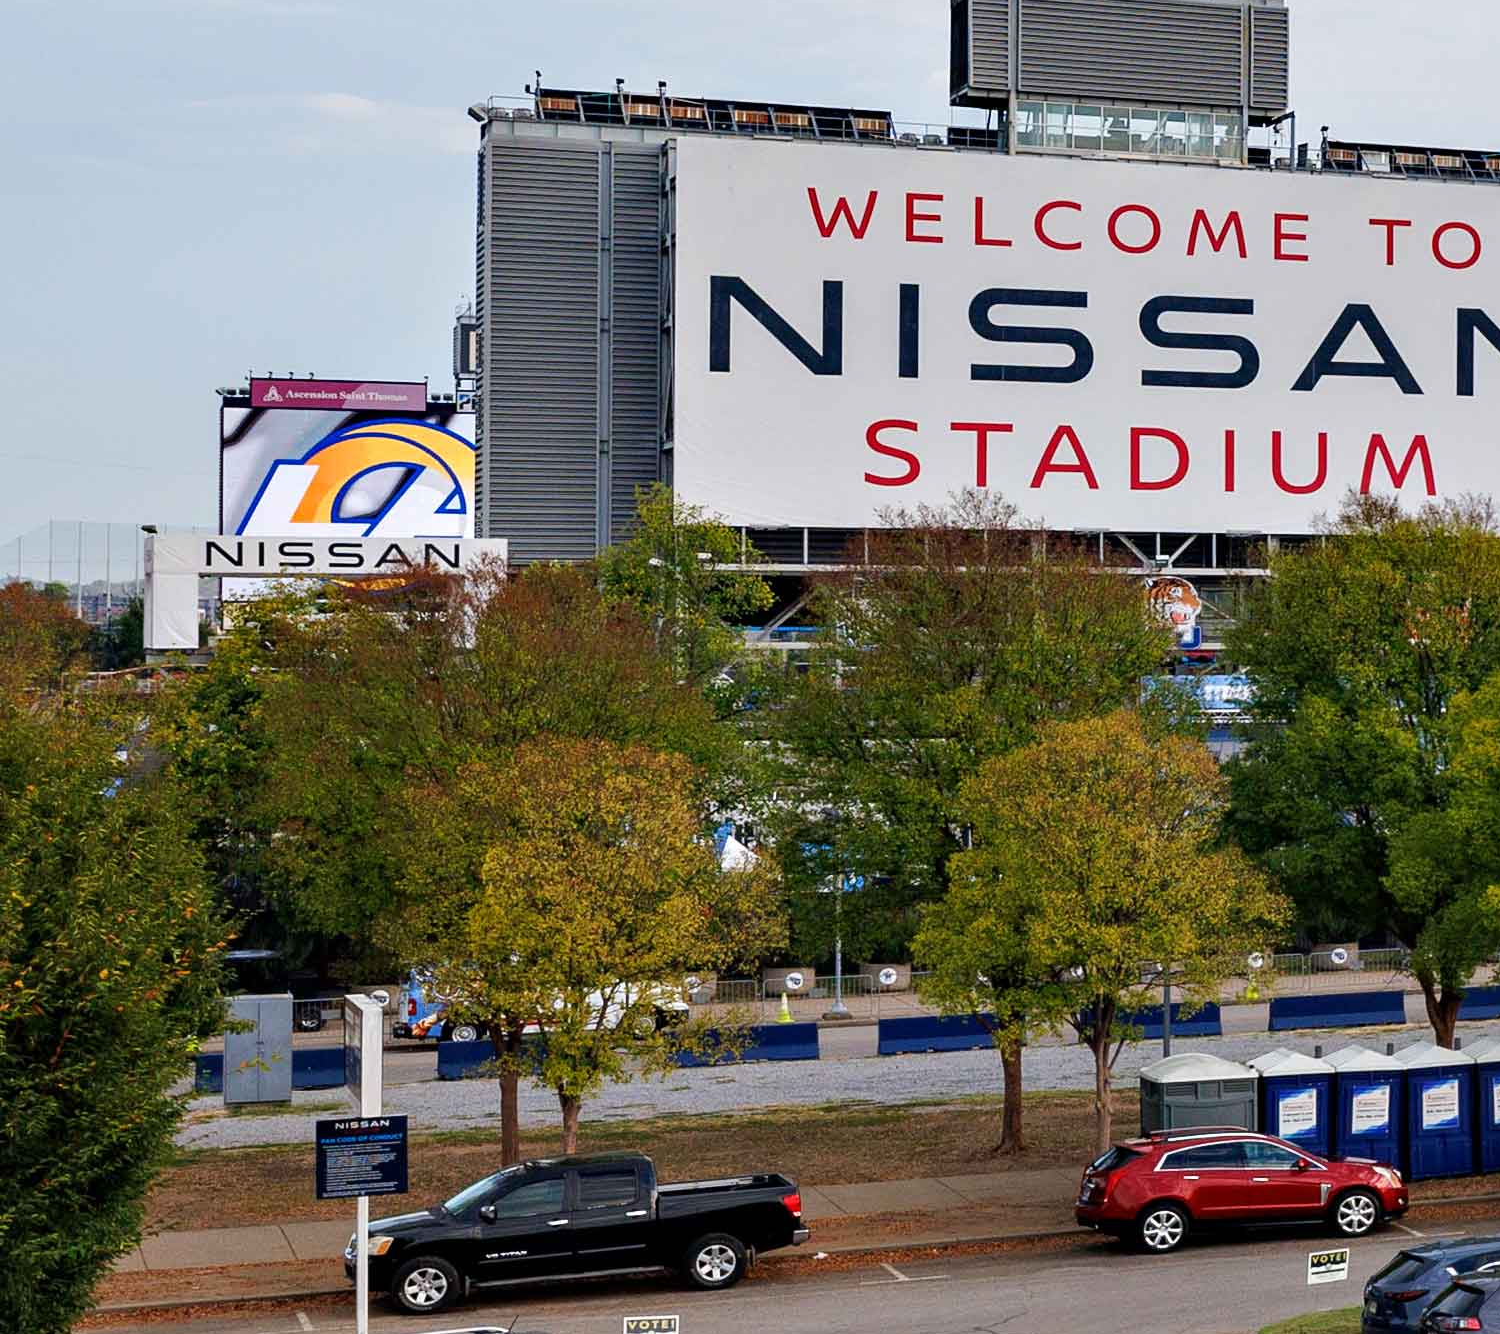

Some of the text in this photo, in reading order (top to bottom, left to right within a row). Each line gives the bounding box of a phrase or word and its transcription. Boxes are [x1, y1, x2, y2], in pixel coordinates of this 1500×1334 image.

[807, 186, 1482, 270] WELCOME TO
[286, 389, 409, 403] Ascension Saint Thomas
[863, 419, 1437, 496] STADIUM
[205, 541, 461, 568] NISSAN
[335, 1119, 390, 1131] NISSAN
[1312, 1251, 1347, 1265] VOTE!
[628, 1320, 676, 1331] VOTE!
